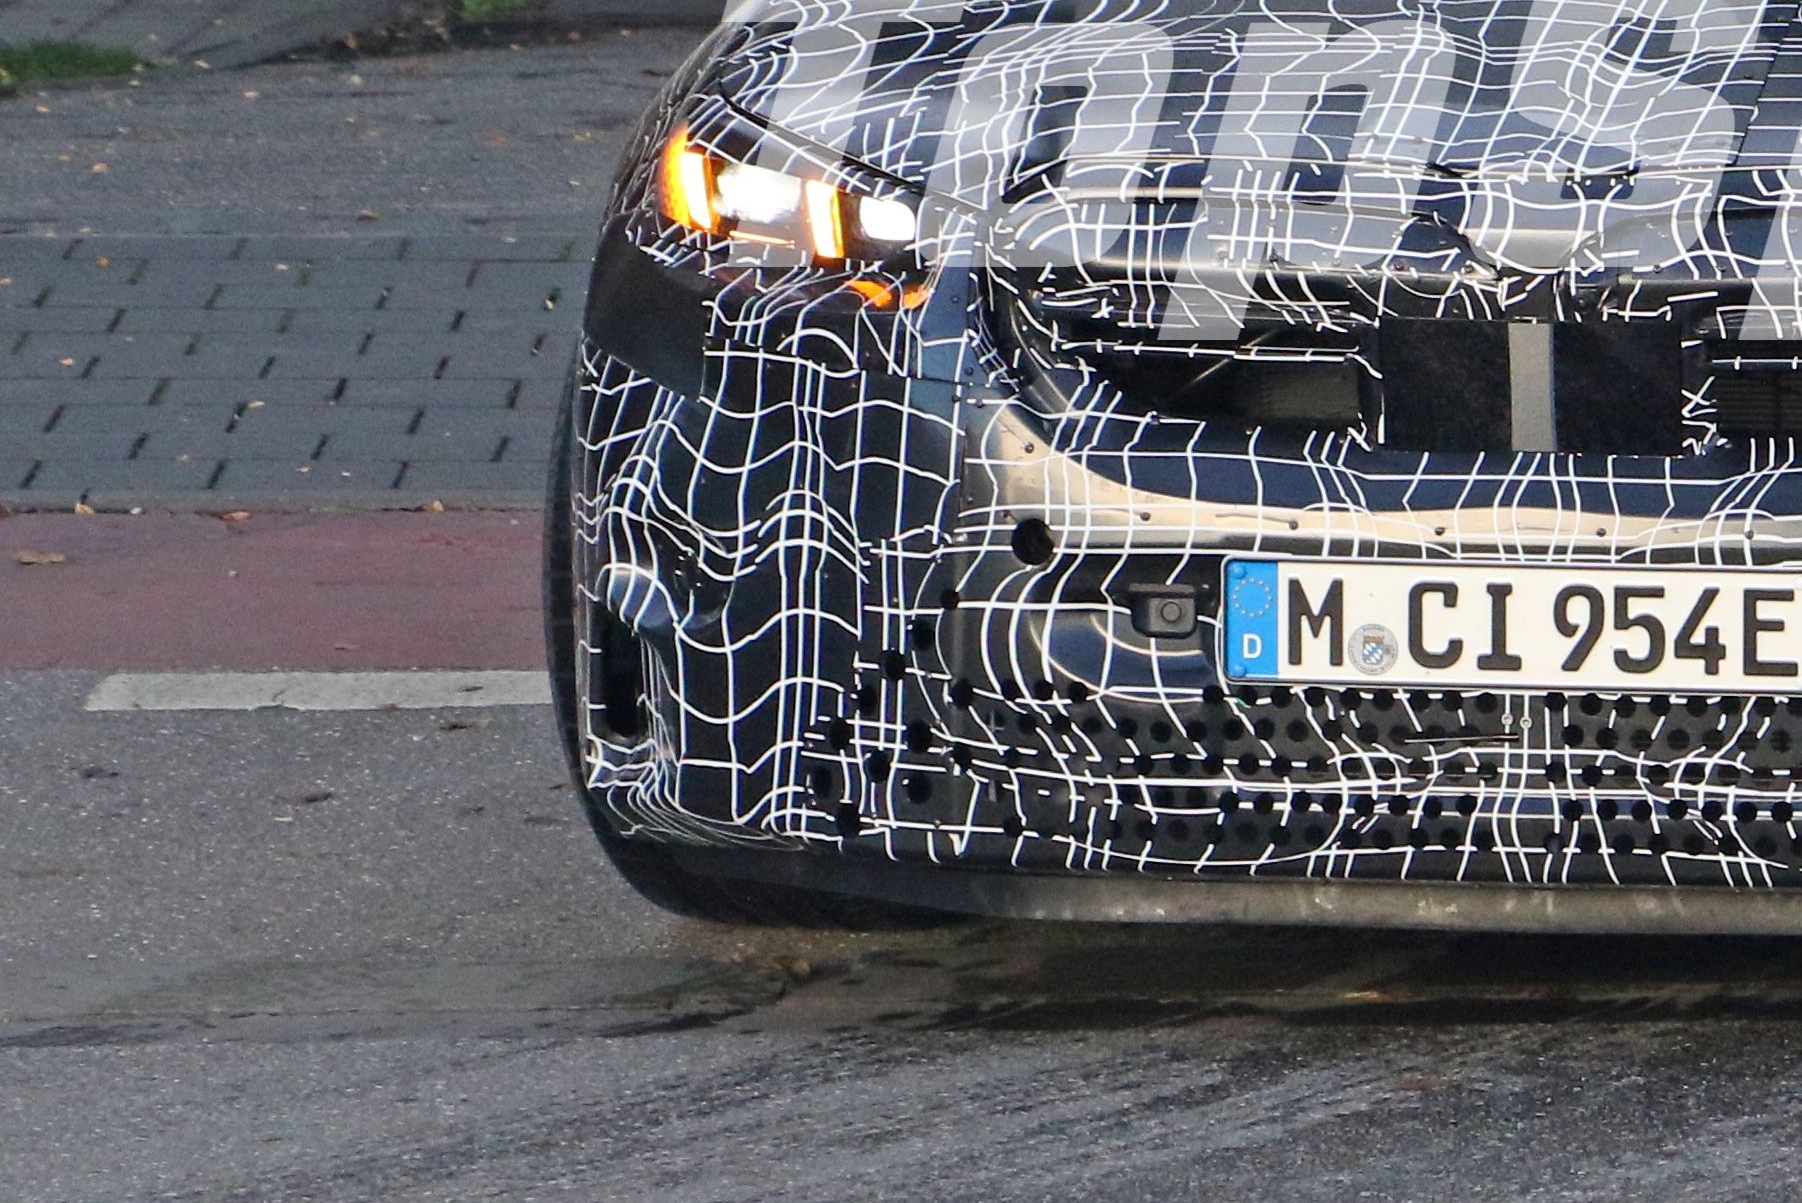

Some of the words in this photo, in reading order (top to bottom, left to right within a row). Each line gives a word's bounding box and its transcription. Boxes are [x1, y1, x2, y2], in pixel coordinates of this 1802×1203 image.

[1242, 633, 1263, 659] D
[1287, 577, 1344, 666] M
[1552, 583, 1799, 677] 954E
